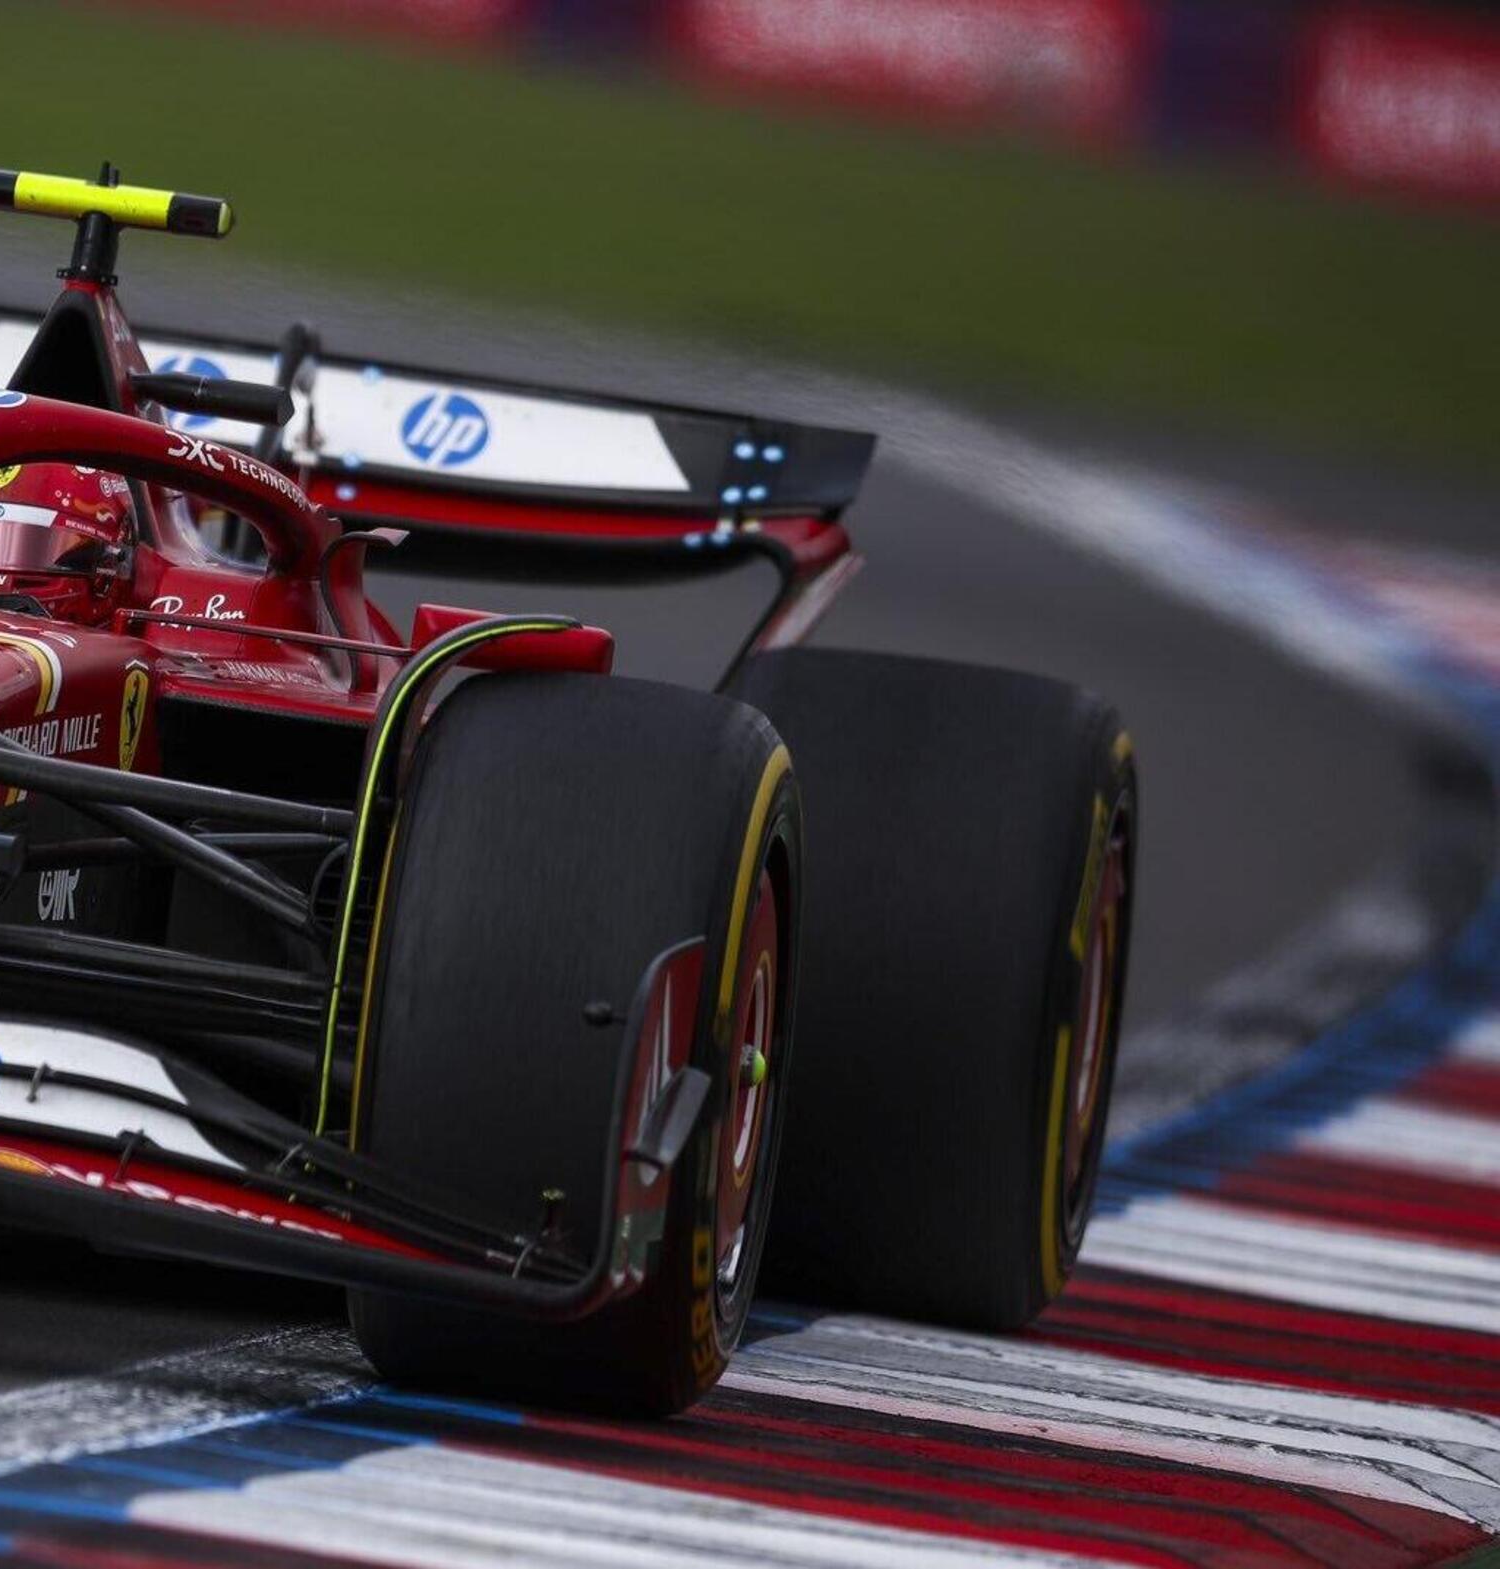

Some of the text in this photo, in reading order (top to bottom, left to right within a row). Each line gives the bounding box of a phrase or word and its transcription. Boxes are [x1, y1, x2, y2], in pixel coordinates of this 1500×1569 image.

[164, 429, 226, 473] DXC
[407, 391, 485, 467] hp
[60, 713, 102, 755] MILLE
